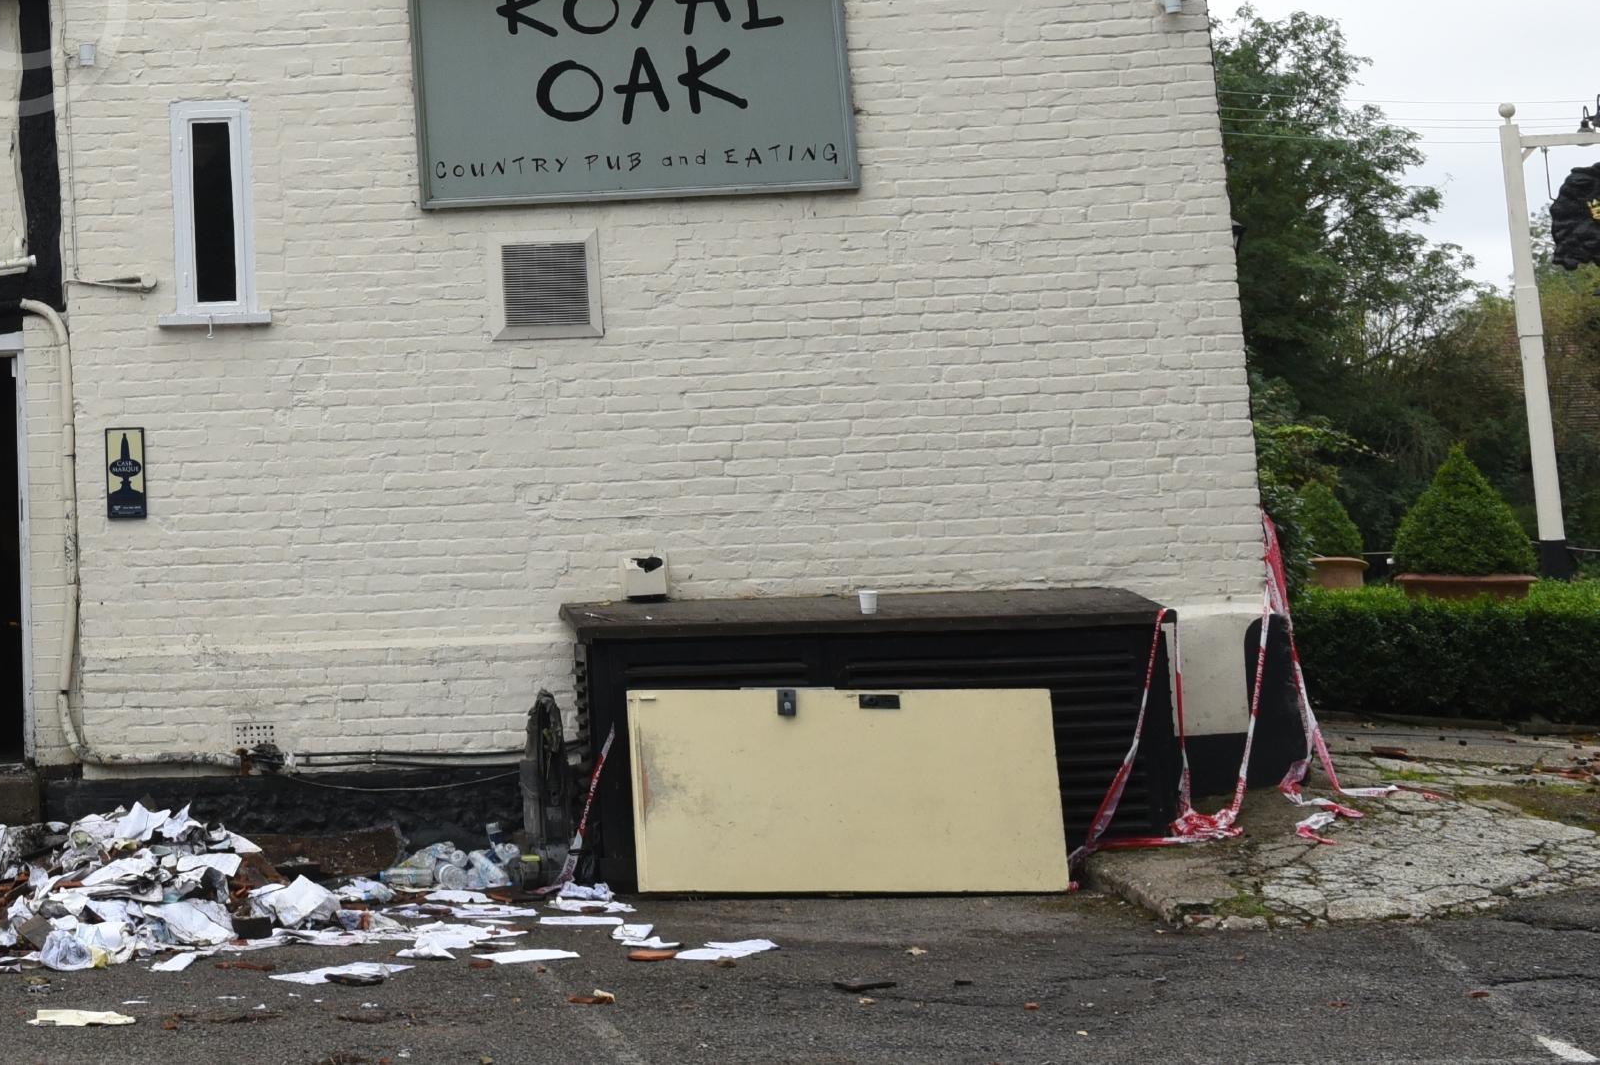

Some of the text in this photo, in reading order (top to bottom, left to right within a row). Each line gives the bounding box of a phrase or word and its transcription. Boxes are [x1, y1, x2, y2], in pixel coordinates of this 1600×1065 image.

[536, 45, 748, 125] OAK
[435, 142, 840, 180] COUNTRY PUB and EATING
